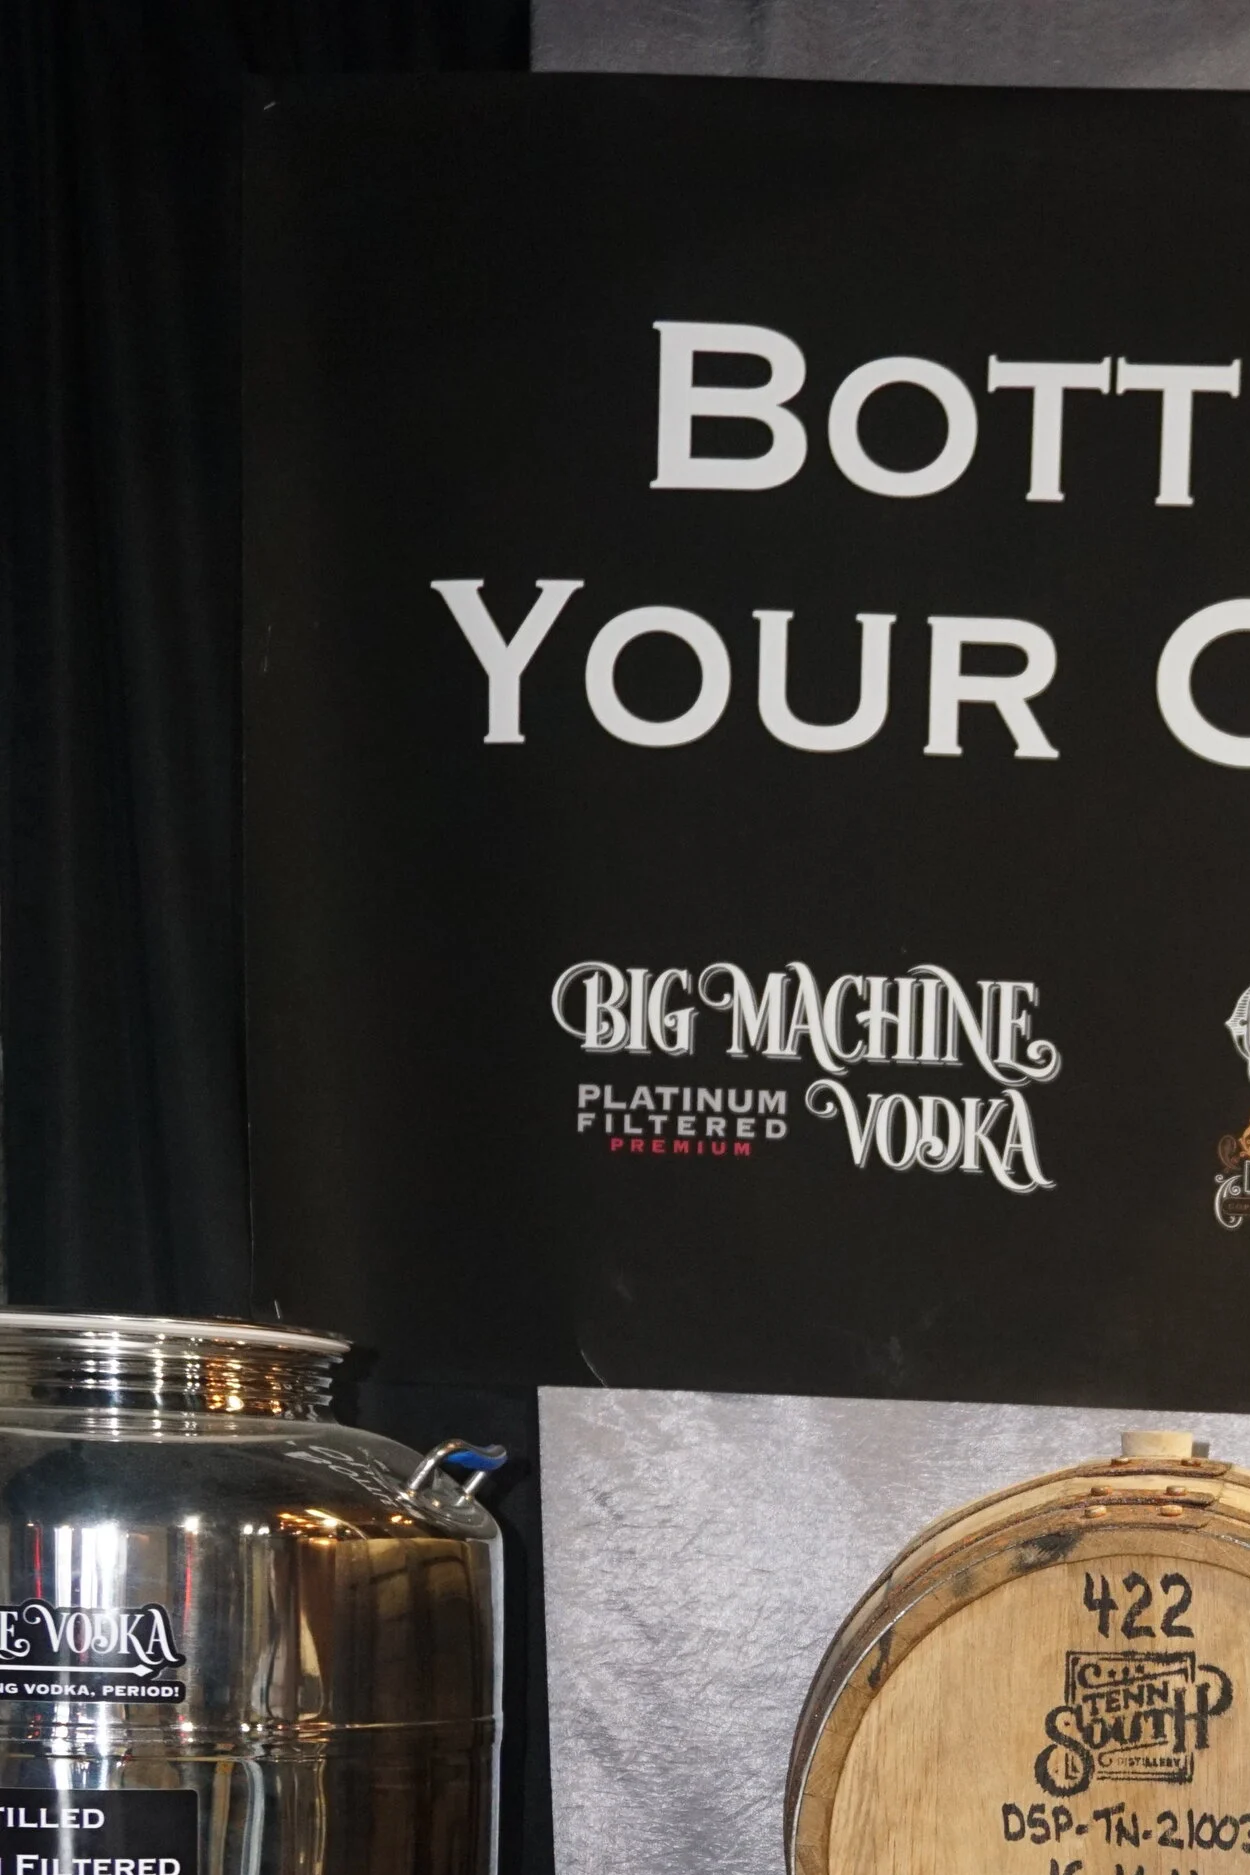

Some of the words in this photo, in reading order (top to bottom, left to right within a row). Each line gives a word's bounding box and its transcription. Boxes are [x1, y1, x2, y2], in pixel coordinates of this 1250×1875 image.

[430, 578, 1059, 758] YOUR
[551, 961, 699, 1056] BIG
[699, 961, 1062, 1085] MACHINE
[577, 1083, 787, 1116] PLATINUM
[576, 1112, 788, 1139] FILTERED
[610, 1137, 752, 1157] PREMIUM
[805, 1078, 1057, 1194] VODKA
[1083, 1571, 1195, 1640] 422
[23, 1604, 181, 1665] VODKA
[24, 1682, 97, 1698] VODKA,
[102, 1684, 181, 1698] PERIOD!
[1082, 1681, 1171, 1717] TENN
[1034, 1664, 1234, 1798] SOUTH
[0, 1807, 105, 1829] ILLED
